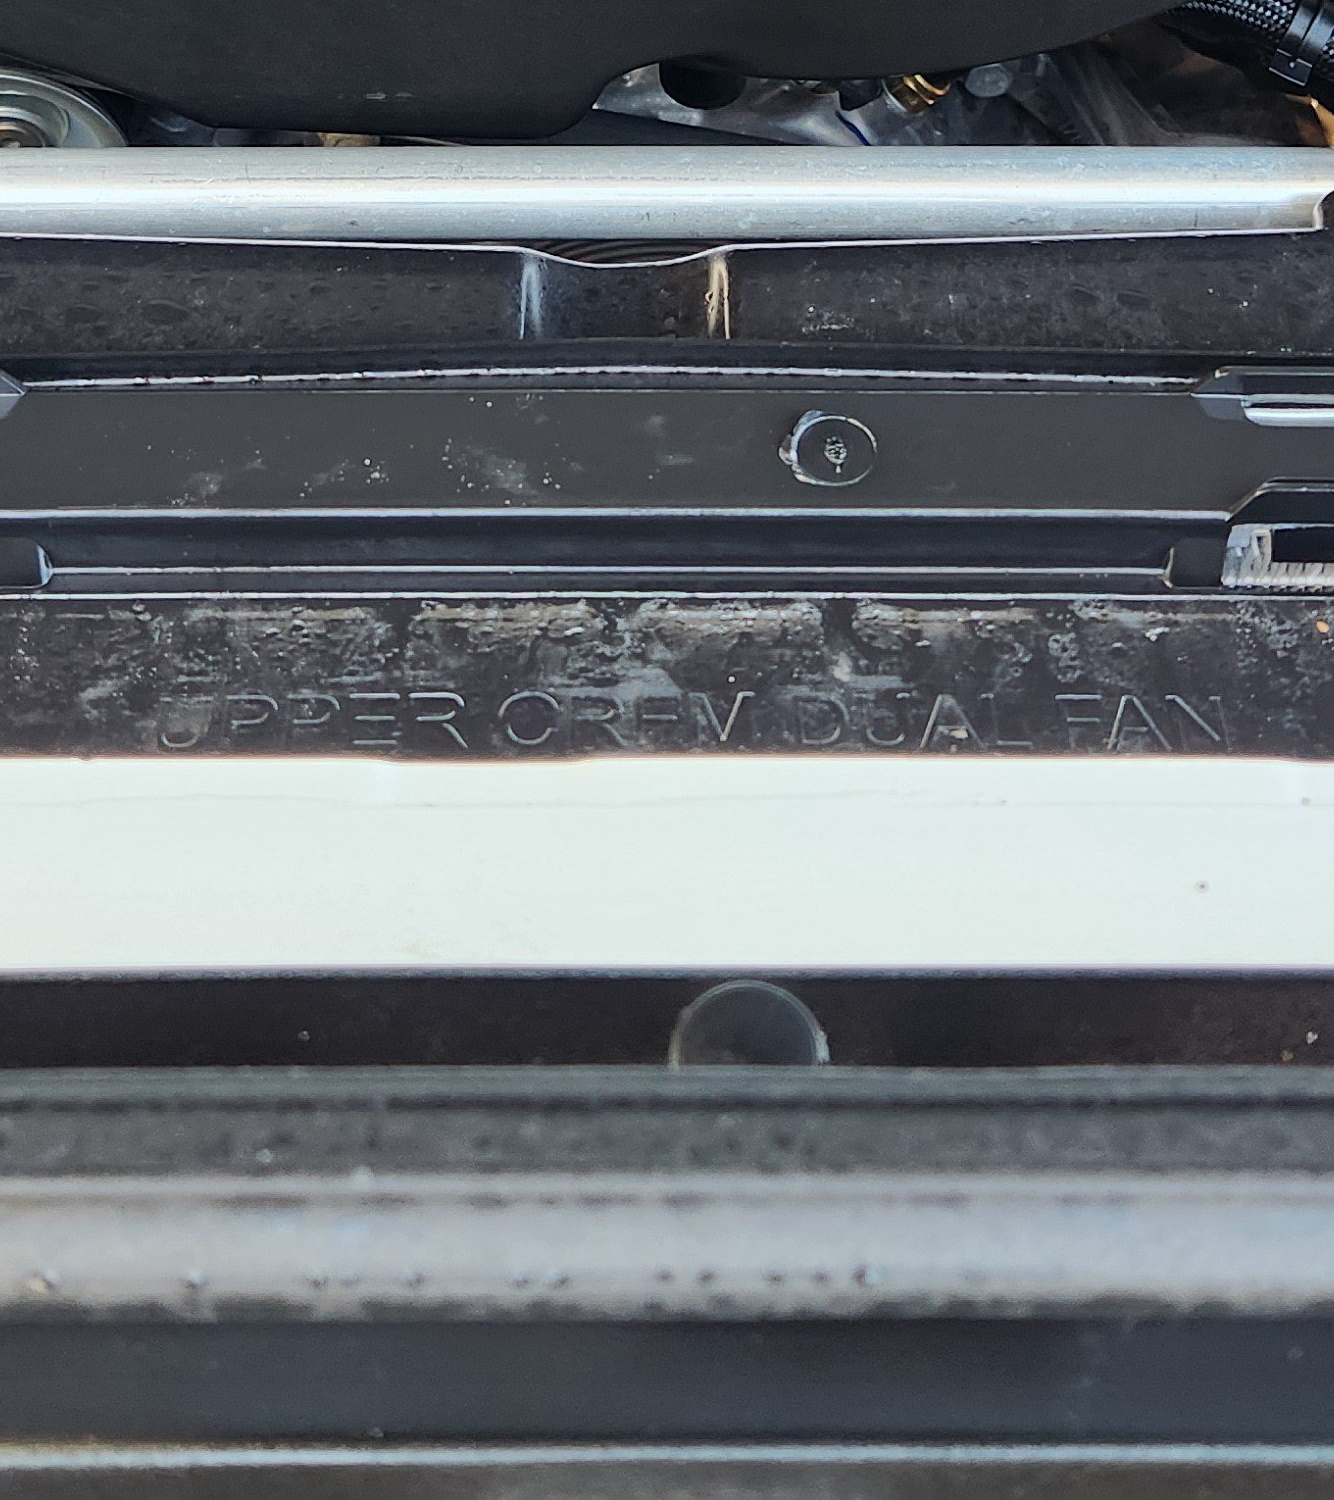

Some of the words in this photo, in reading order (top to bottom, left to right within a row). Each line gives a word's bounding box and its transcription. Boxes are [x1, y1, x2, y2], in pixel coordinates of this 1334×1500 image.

[157, 691, 469, 749] UPPER
[795, 692, 1035, 750] DUAL
[1055, 692, 1230, 750] FAN
